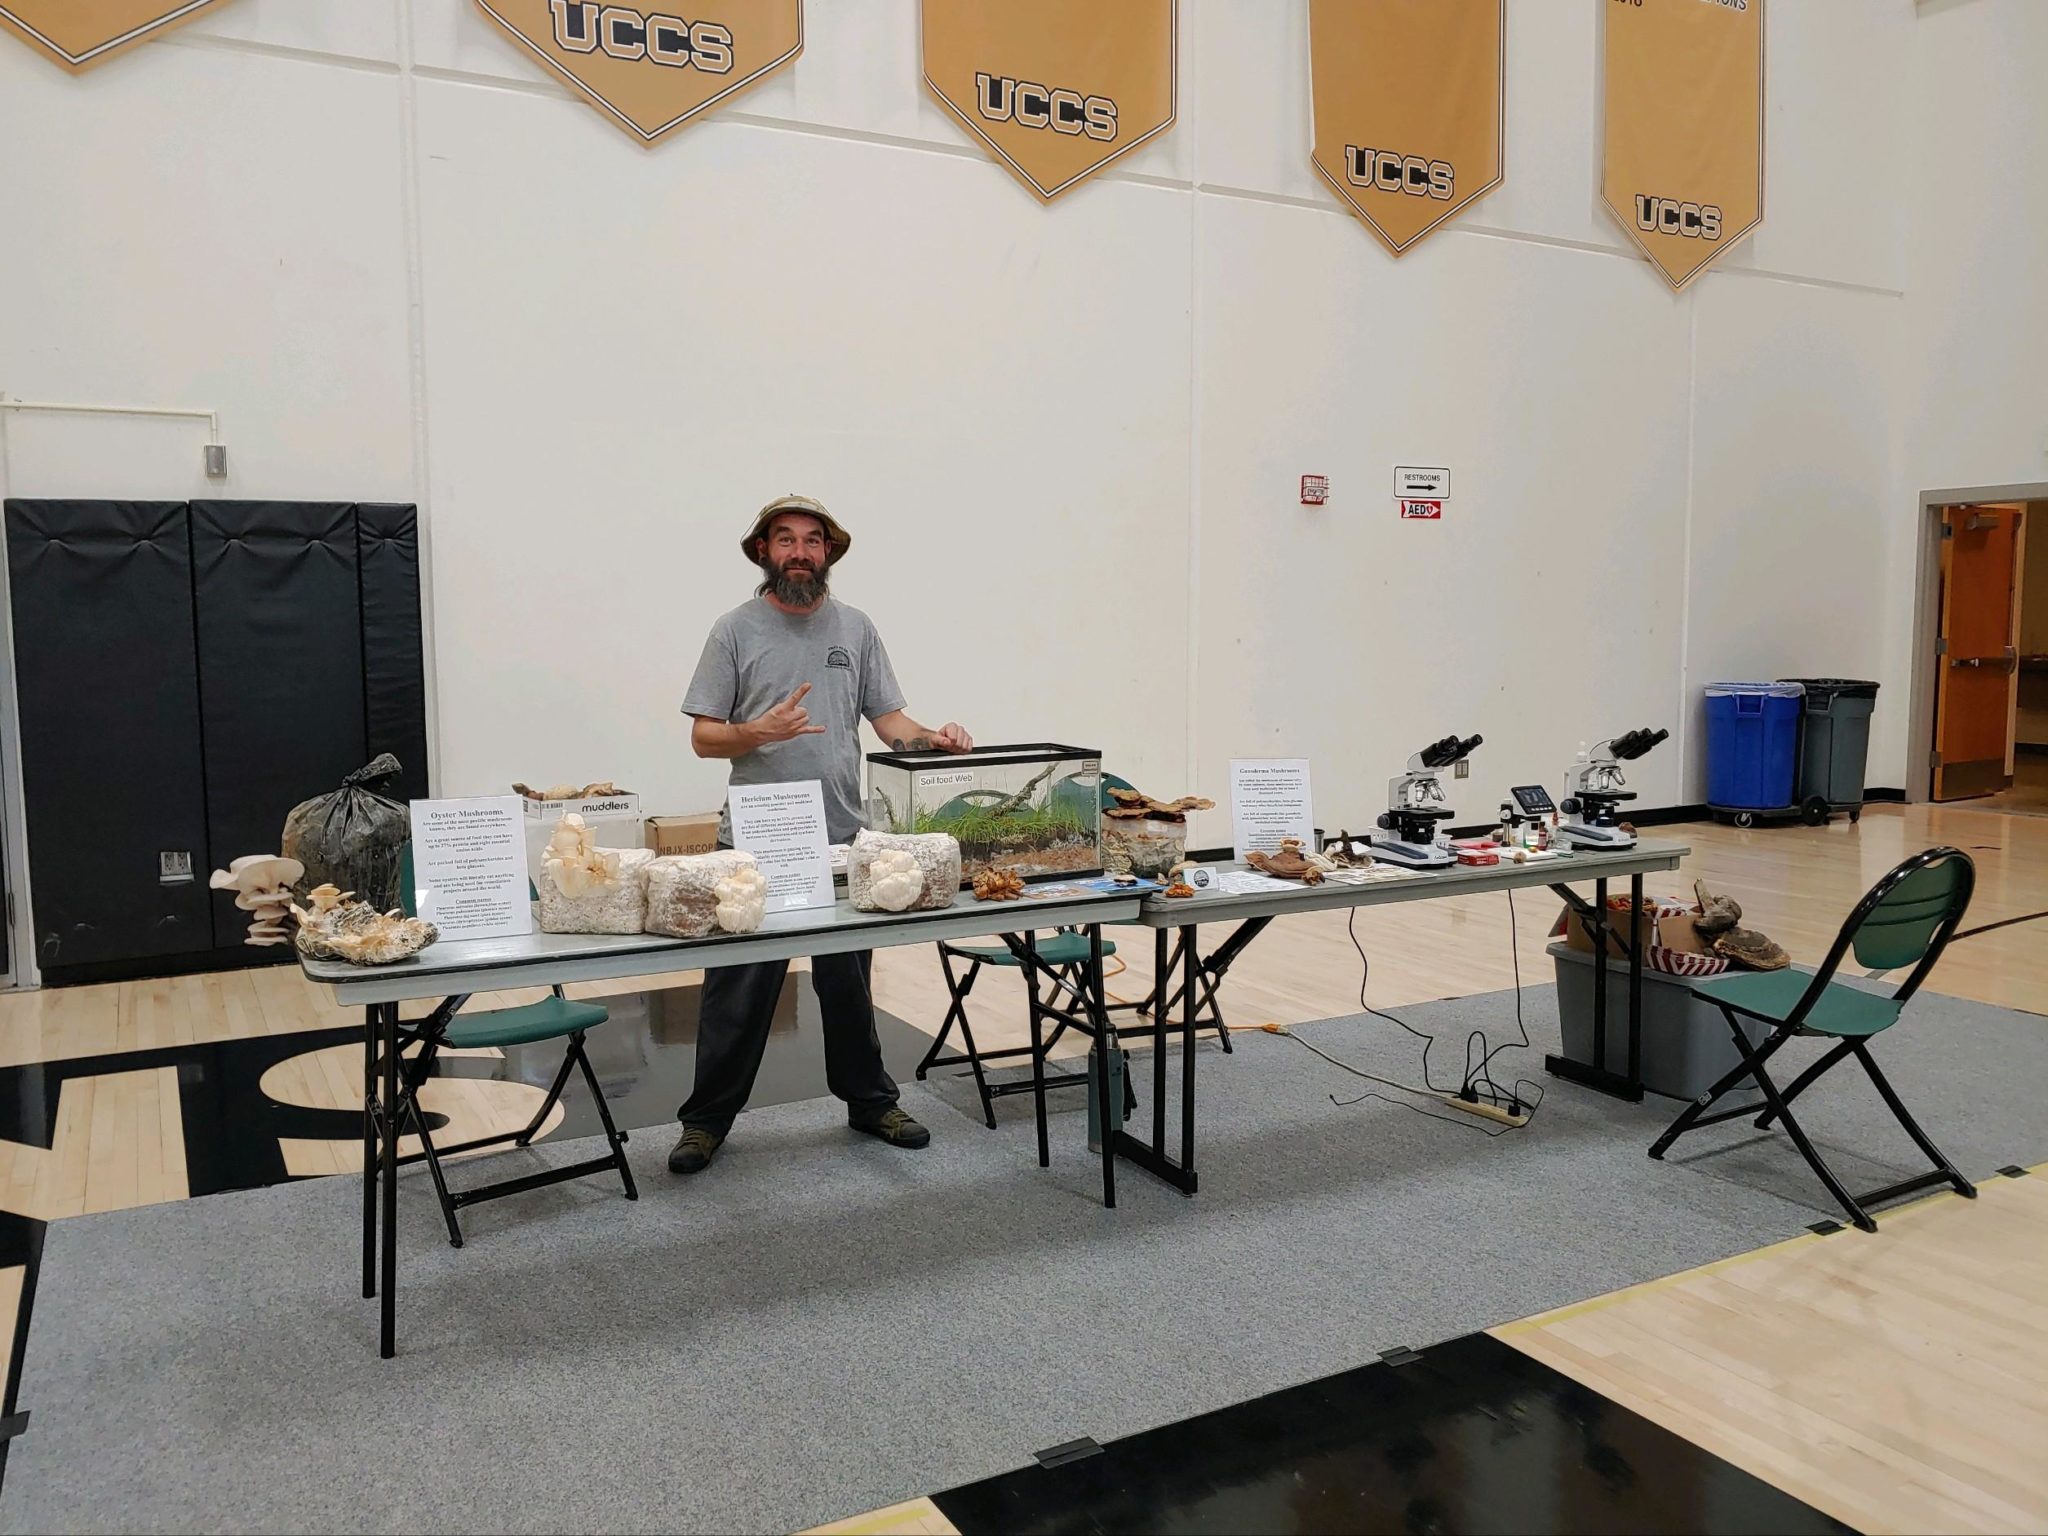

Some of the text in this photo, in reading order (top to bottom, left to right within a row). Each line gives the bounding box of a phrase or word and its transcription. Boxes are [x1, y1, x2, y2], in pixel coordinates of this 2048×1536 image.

[548, 0, 734, 74] UCCS
[976, 72, 1118, 142] UCCS
[1345, 144, 1454, 201] UCCS
[1636, 194, 1722, 240] UCCS
[1404, 474, 1441, 482] RESTROOMS
[1408, 504, 1426, 514] AED
[920, 773, 972, 786] Soil food Web
[582, 802, 629, 812] muddlers
[431, 811, 456, 820] Oyster
